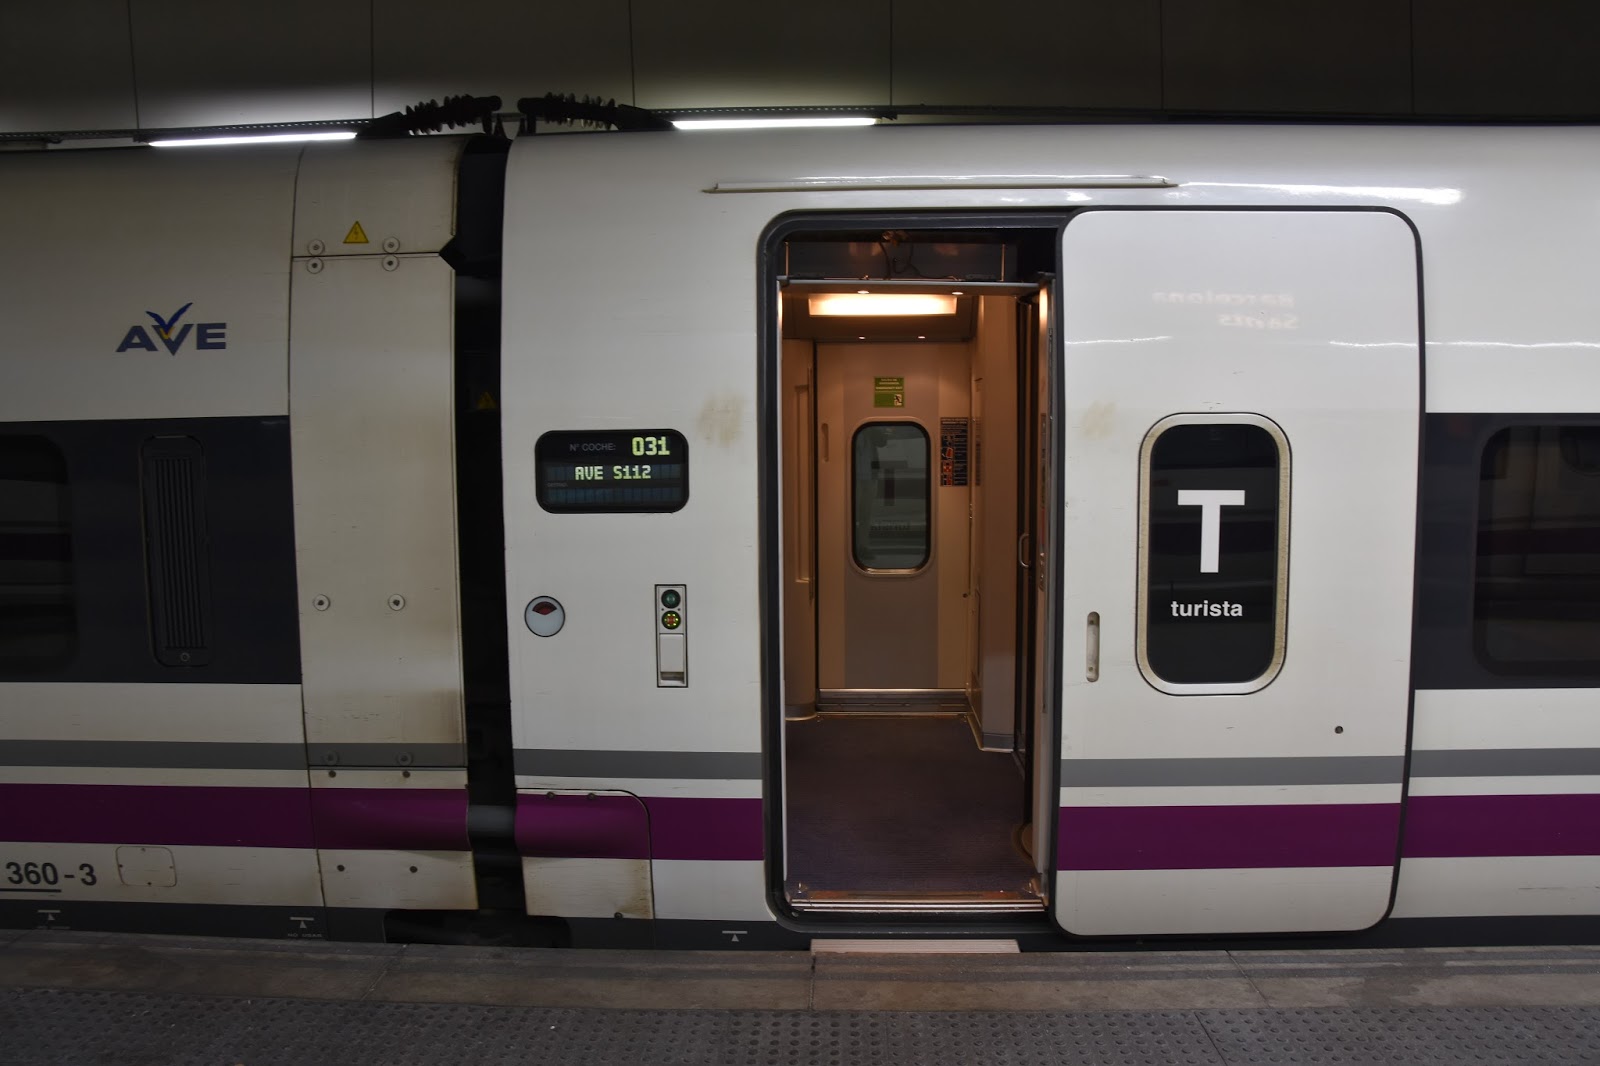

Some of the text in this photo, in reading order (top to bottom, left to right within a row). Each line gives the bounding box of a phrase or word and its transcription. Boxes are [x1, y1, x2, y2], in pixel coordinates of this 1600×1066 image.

[115, 322, 227, 356] AVE
[581, 442, 617, 451] COCHE:
[631, 436, 671, 456] 031
[575, 464, 652, 480] AVE S112
[1178, 489, 1245, 573] T
[1170, 600, 1243, 617] turista
